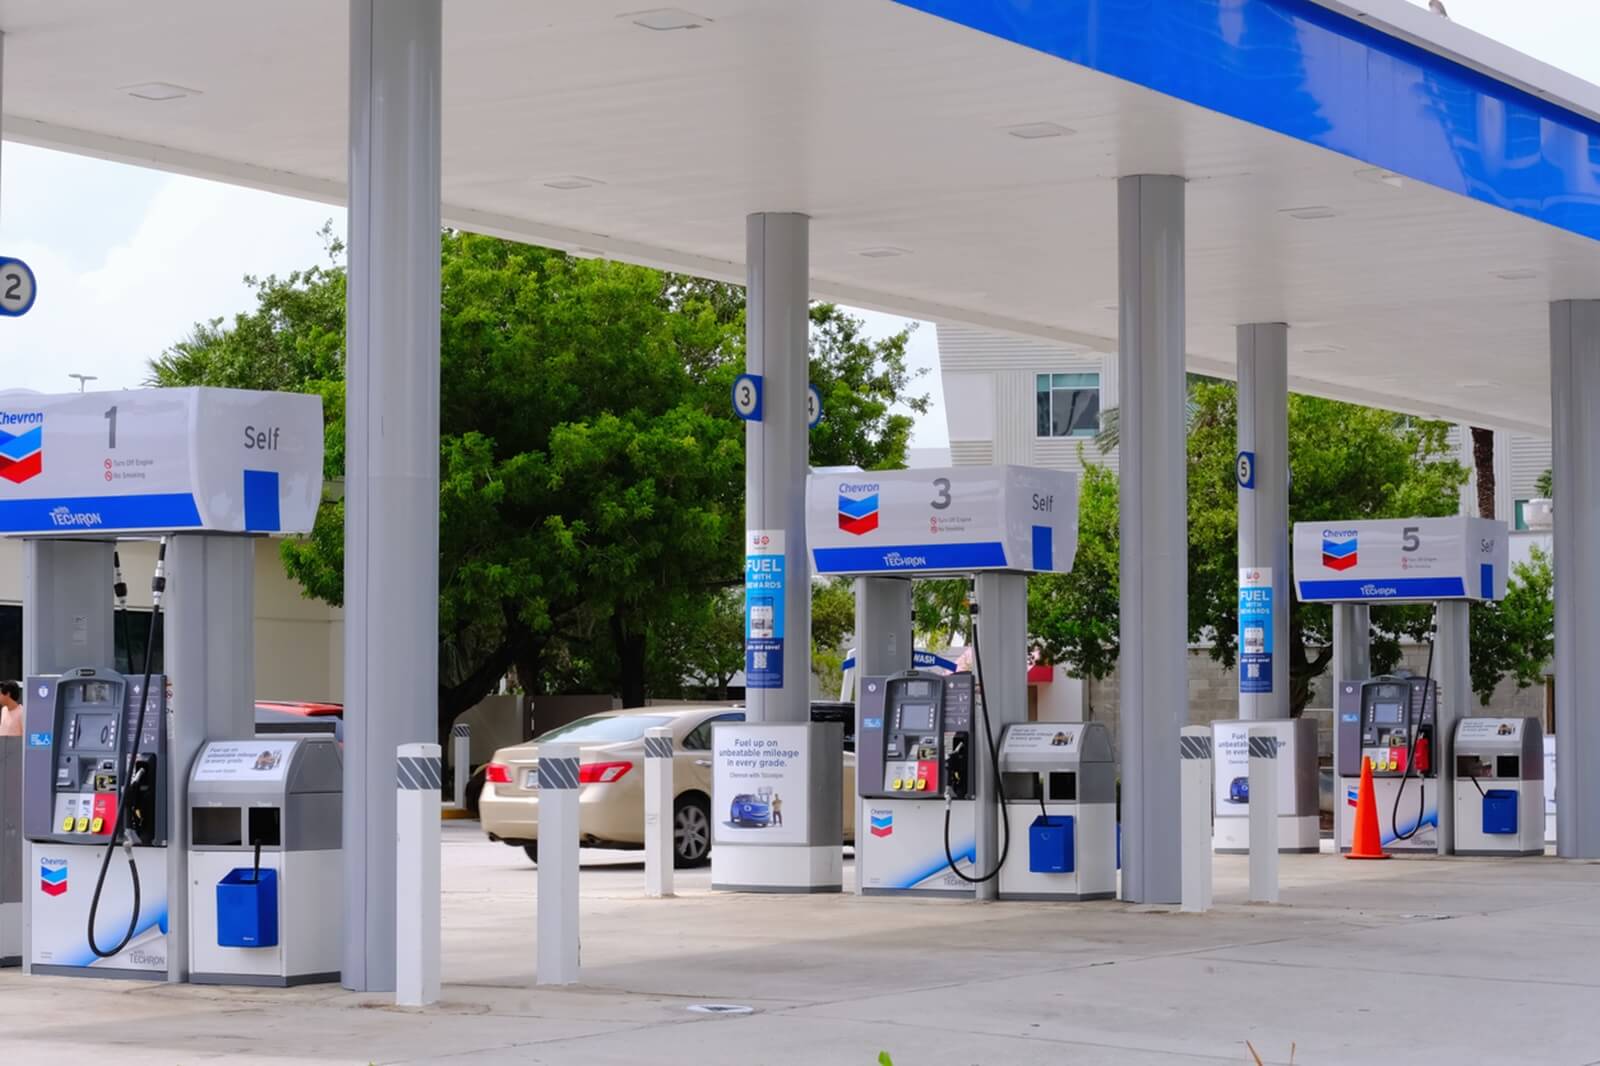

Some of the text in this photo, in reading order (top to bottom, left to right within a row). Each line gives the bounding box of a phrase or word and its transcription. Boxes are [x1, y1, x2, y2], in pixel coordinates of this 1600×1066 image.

[5, 273, 21, 300] 2
[741, 385, 751, 407] 3
[104, 406, 118, 449] 1
[244, 425, 280, 450] Self
[1240, 461, 1248, 477] 5
[839, 482, 880, 493] Chevron
[930, 477, 952, 510] 3
[1032, 493, 1055, 512] Self
[49, 511, 102, 527] TECHRON
[1322, 529, 1358, 538] Chevron
[1402, 526, 1420, 552] 5
[882, 556, 926, 567] TECHRON
[734, 738, 752, 747] Fuel
[719, 748, 800, 758] unbeatable mileage
[727, 759, 734, 767] in
[736, 760, 757, 768] every
